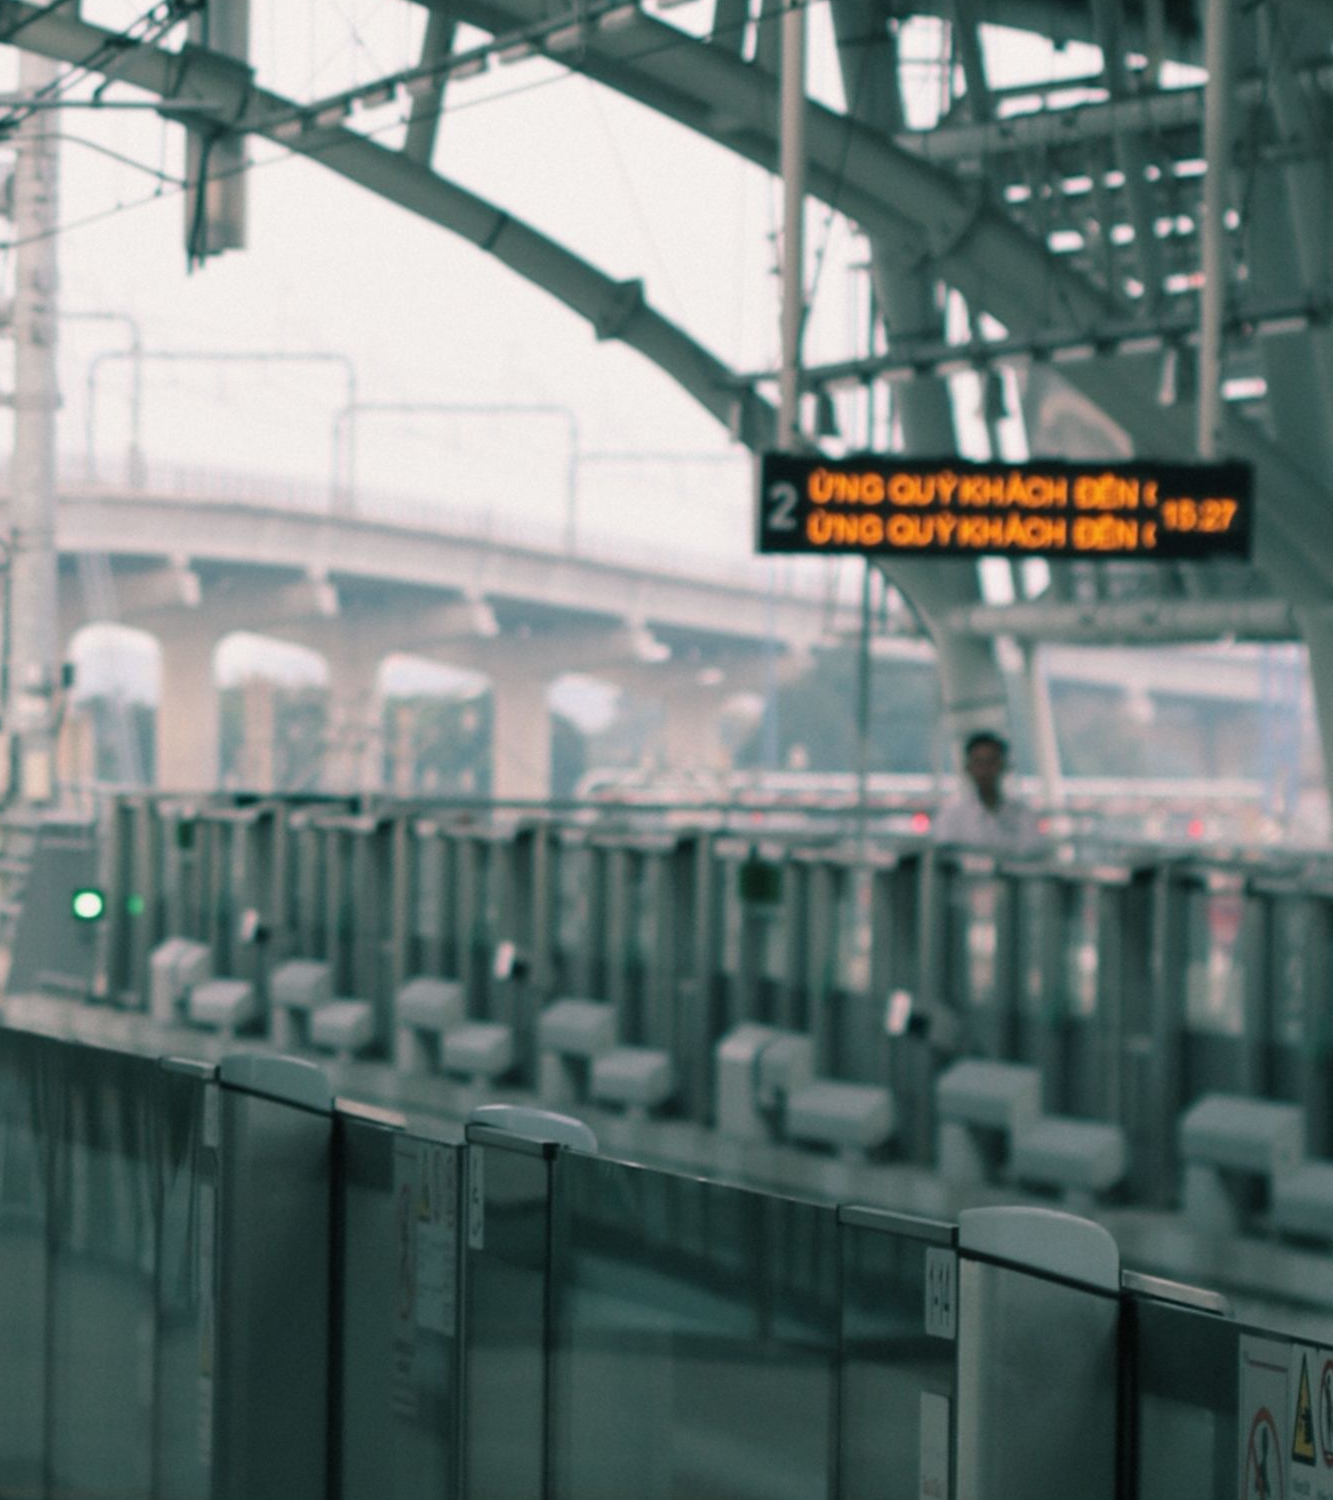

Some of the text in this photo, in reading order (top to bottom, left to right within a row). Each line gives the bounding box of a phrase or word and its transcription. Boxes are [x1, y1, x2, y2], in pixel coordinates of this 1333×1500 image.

[769, 482, 797, 530] 2
[958, 470, 1067, 508] KHÁCH
[957, 511, 1066, 548] KHÁCH
